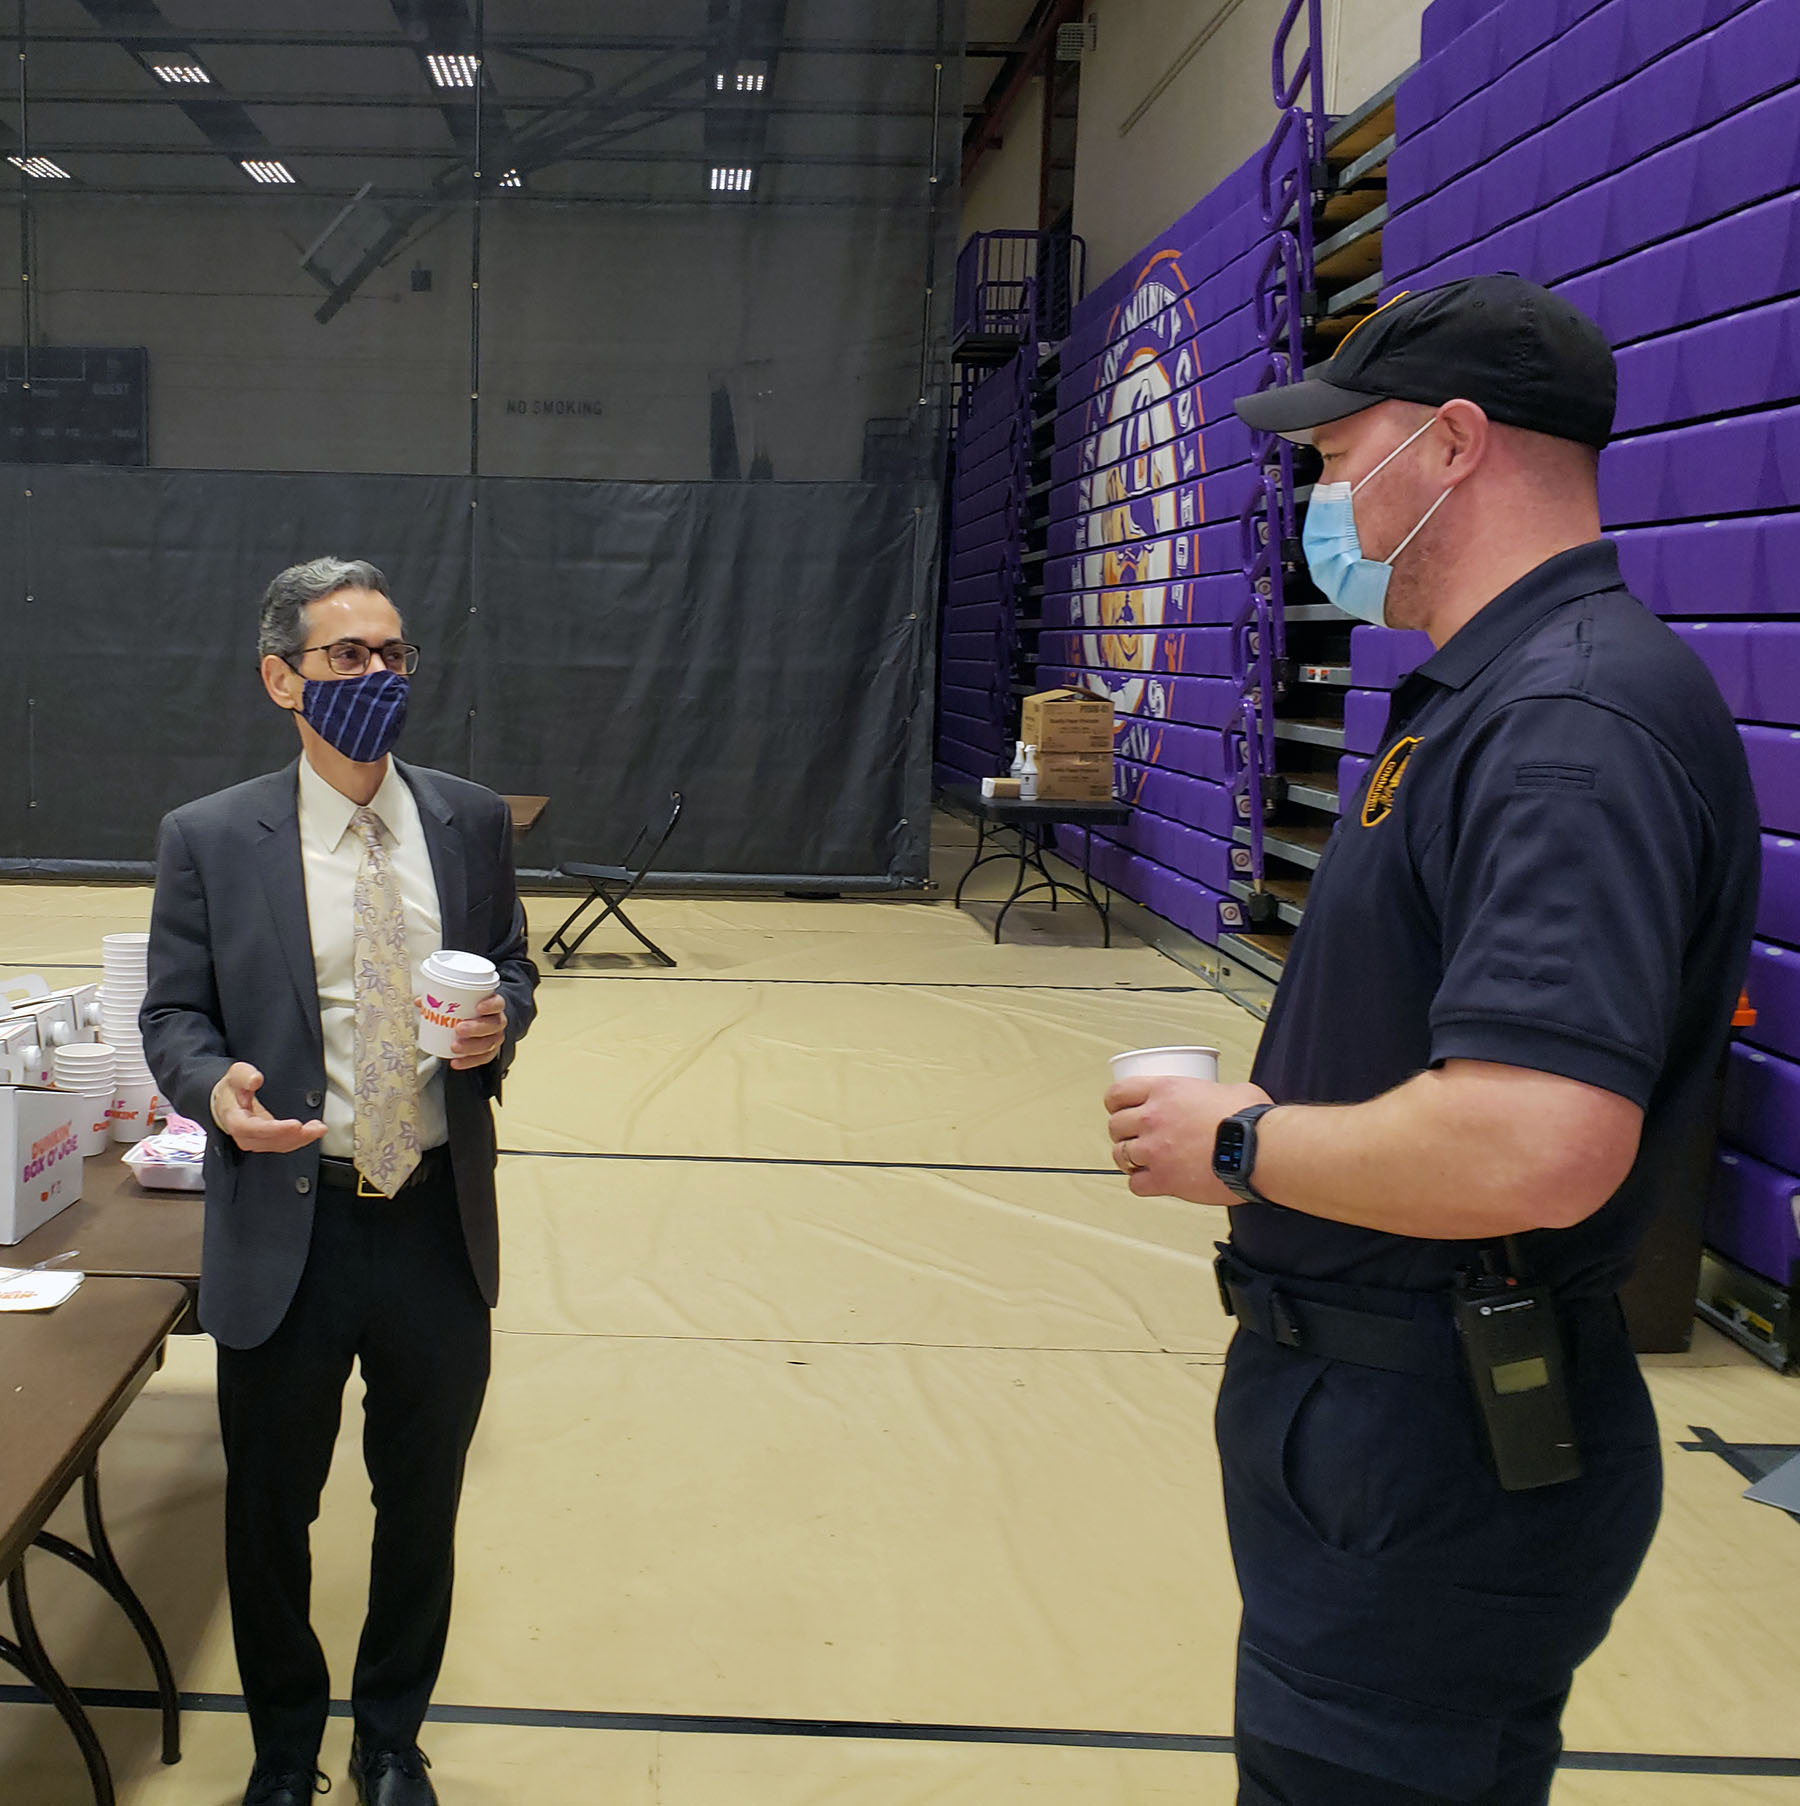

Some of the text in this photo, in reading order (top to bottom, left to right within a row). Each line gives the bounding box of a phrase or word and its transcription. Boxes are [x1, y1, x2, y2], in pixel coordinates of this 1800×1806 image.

[506, 400, 603, 416] NO SMOKING
[24, 1156, 45, 1183] BOX
